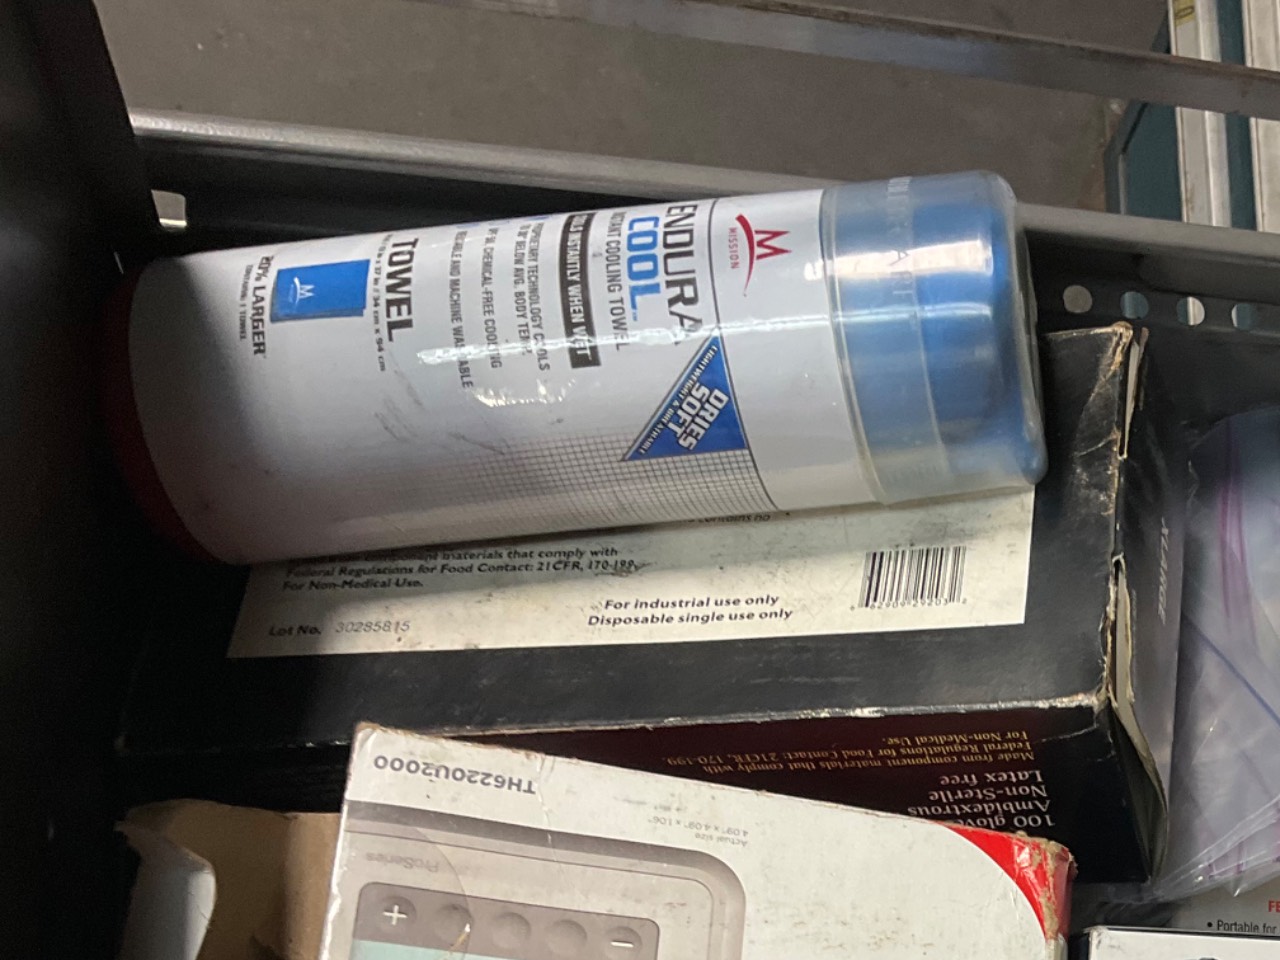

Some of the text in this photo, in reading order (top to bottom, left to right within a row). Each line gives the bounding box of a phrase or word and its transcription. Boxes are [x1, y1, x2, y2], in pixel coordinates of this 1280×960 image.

[727, 226, 740, 269] MISSION
[605, 238, 623, 293] COOLING
[626, 216, 660, 310] COOL
[562, 230, 585, 324] INSTANTLY WHEN
[662, 204, 702, 346] ENDURA
[387, 236, 417, 342] TOWEL
[447, 277, 464, 324] MACHINE
[525, 263, 544, 331] TECHNOLOGY
[513, 289, 528, 320] BODY
[252, 284, 266, 356] LARGER
[667, 381, 710, 437] SOFT
[677, 387, 729, 450] DRIES
[506, 545, 618, 561] that comply with
[439, 561, 534, 574] Food Contact:
[307, 578, 392, 591] Non-Medical
[602, 593, 780, 612] For industrial use only
[334, 618, 411, 634] 30285815
[587, 607, 794, 630] Disposable single use only
[880, 729, 1028, 746] For Non-Medical Use.
[735, 750, 1034, 772] Made from component materials that comply
[781, 741, 1031, 761] Federal Regulations for Food Contact:
[370, 752, 538, 794] TH6220U2000
[937, 767, 1042, 789] Latex free
[926, 783, 1046, 803] Non-Sterile
[906, 798, 1051, 819] Ambidextrous
[1011, 811, 1055, 830] 100
[1216, 919, 1259, 932] Portable
